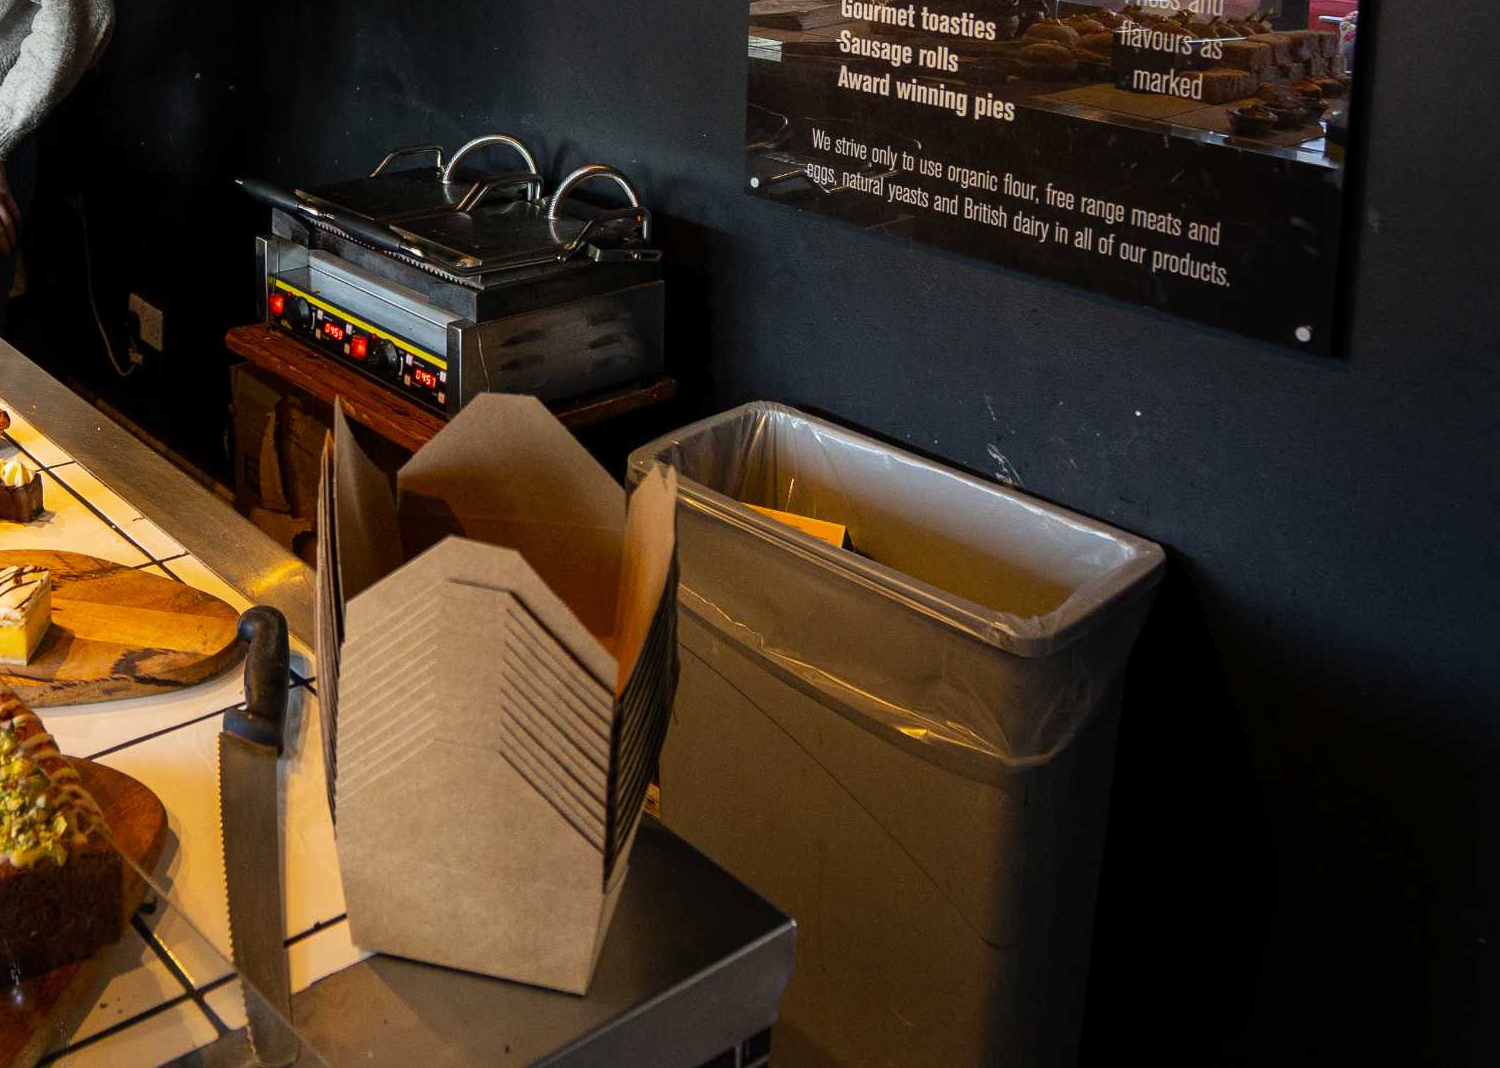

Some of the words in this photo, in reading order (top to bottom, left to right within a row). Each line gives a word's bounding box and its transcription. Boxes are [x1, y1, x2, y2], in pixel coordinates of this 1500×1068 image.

[921, 5, 996, 41] toasties
[1120, 20, 1192, 54] flavours
[1200, 37, 1224, 60] as
[839, 31, 913, 68] Sausage
[918, 44, 959, 73] rolls
[838, 65, 891, 97] Award
[896, 78, 968, 118] winning
[973, 92, 1015, 122] pies
[1133, 69, 1203, 100] marked
[812, 128, 832, 152] We
[835, 136, 868, 161] strive
[871, 144, 898, 171] only
[902, 150, 915, 171] to
[919, 158, 942, 177] use
[948, 164, 998, 192] organic
[1003, 172, 1040, 203] flour,
[1045, 181, 1075, 208] free
[1080, 194, 1125, 226] range
[1131, 206, 1183, 239] meats
[1188, 222, 1220, 246] and
[806, 163, 837, 186] eggs,
[842, 170, 883, 197] natural
[888, 182, 930, 208] yeasts
[933, 191, 958, 215] and
[964, 196, 1007, 230] British
[1013, 208, 1049, 243] dairy
[1054, 221, 1068, 244] in
[1074, 225, 1094, 252] all
[1099, 233, 1115, 256] of
[1119, 240, 1146, 263] our
[1152, 249, 1230, 286] products.
